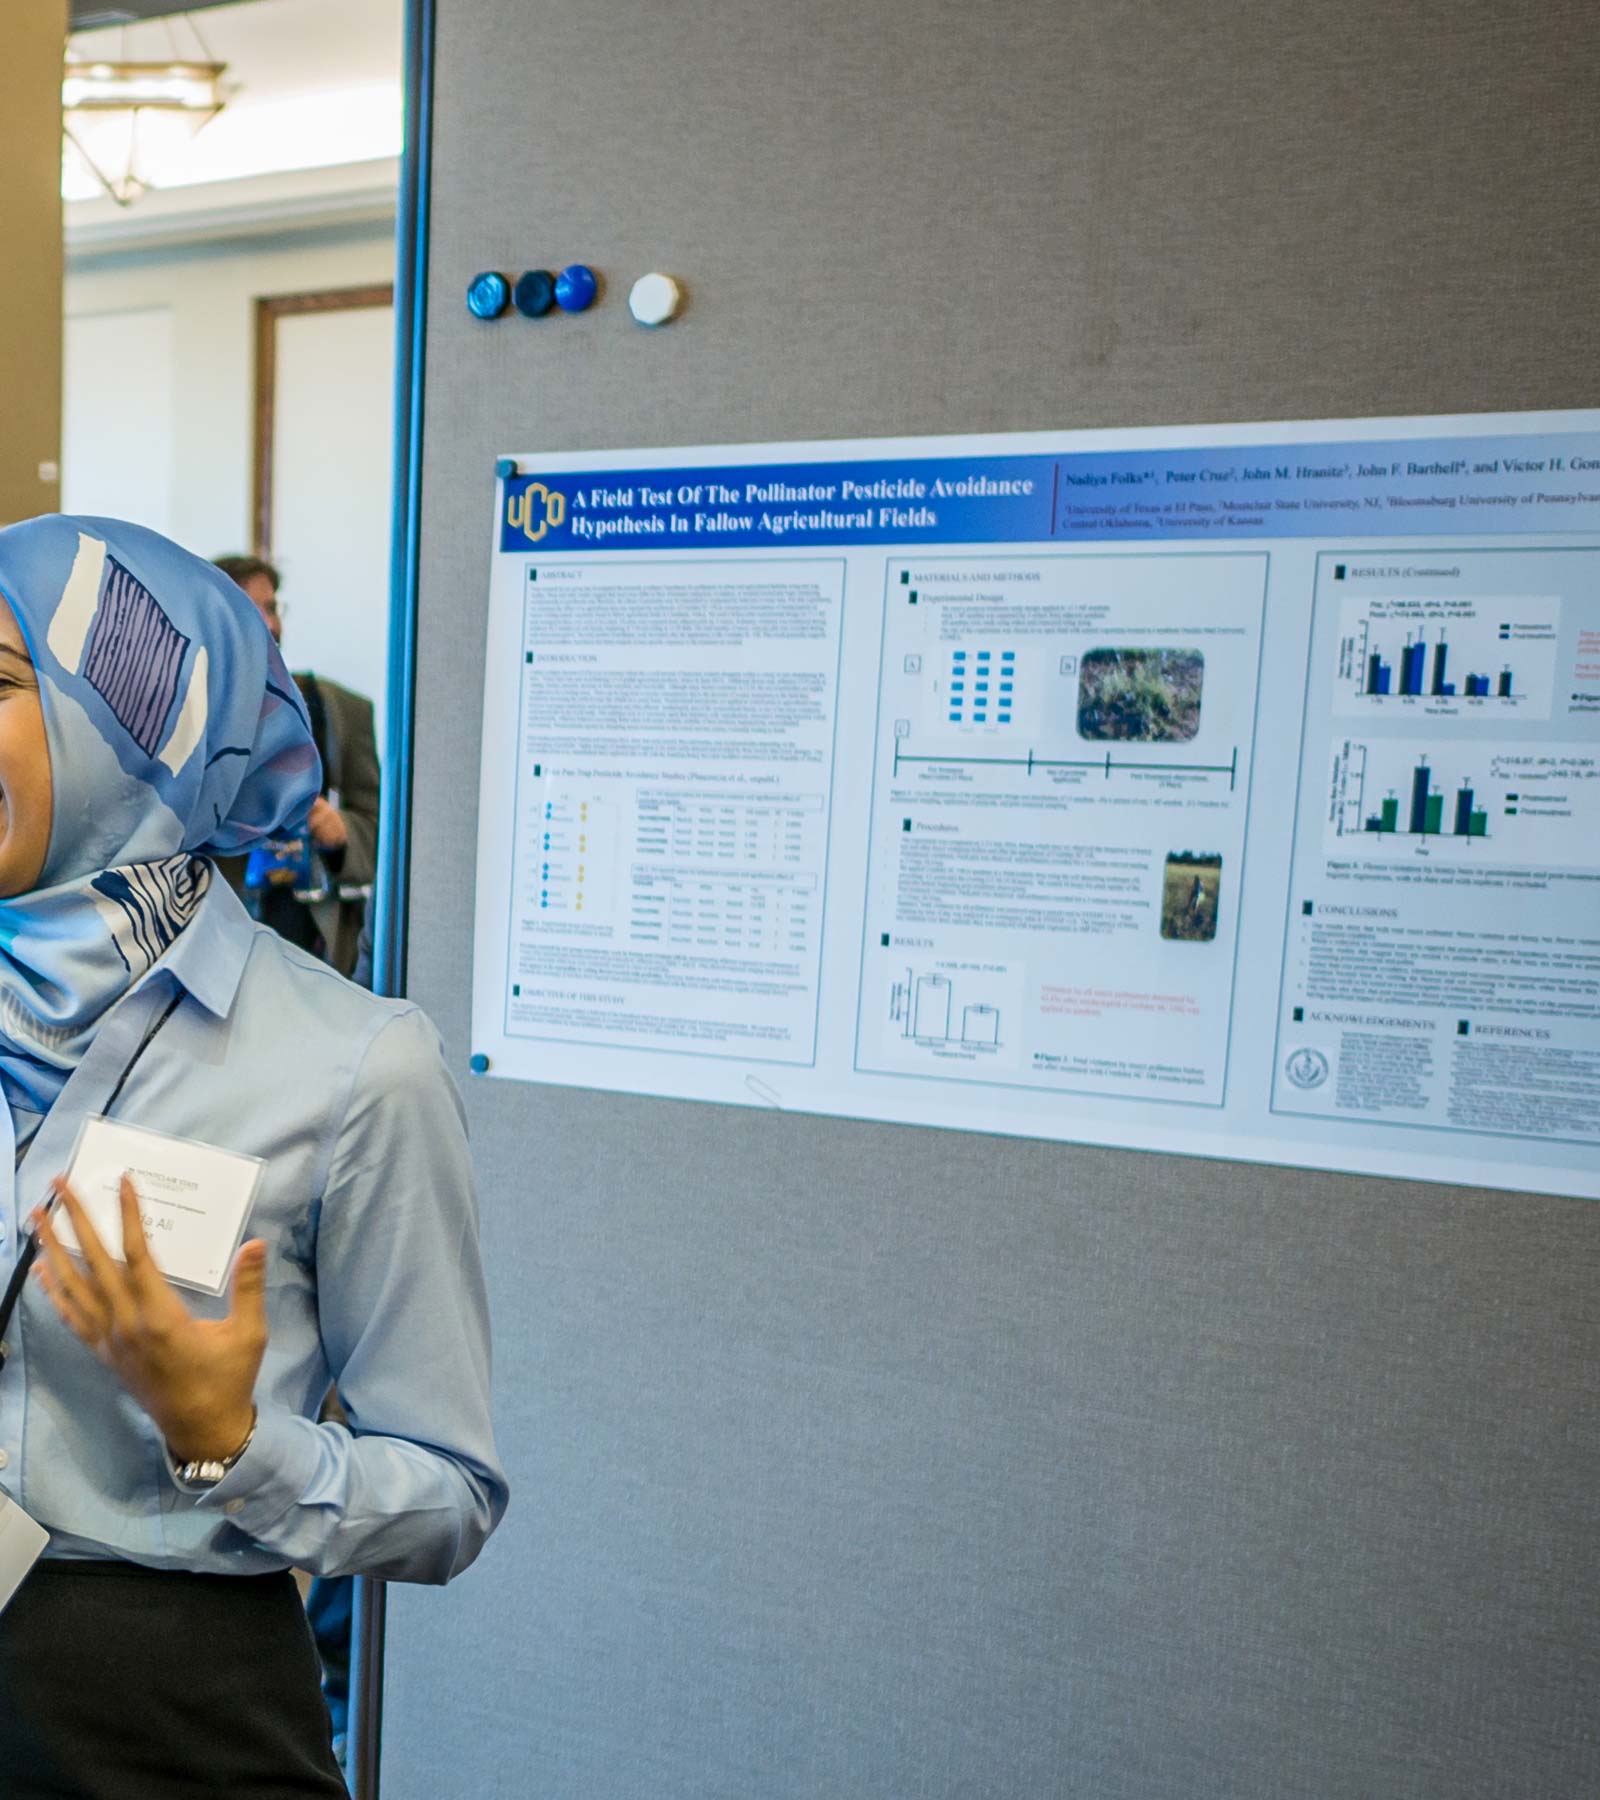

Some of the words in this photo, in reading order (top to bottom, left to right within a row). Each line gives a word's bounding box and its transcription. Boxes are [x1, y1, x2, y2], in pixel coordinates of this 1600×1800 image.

[1165, 469, 1197, 484] Peter
[1242, 467, 1271, 481] John
[1274, 466, 1292, 480] M.
[1356, 463, 1387, 478] John
[1472, 460, 1499, 474] and
[1502, 458, 1545, 473] Victor
[1549, 457, 1565, 471] H.
[571, 490, 587, 509] A
[590, 486, 634, 508] Field
[638, 486, 673, 507] Test
[677, 485, 703, 505] Of
[704, 484, 740, 504] The
[745, 482, 837, 504] Pollinator
[842, 478, 926, 500] Pesticide
[930, 475, 1034, 498] Avoidance
[1520, 493, 1534, 504] of
[571, 514, 665, 540] Hypothesis
[669, 513, 689, 533] In
[694, 511, 753, 533] Fallow
[757, 508, 873, 535] Agricultural
[879, 506, 937, 528] Fields
[1317, 903, 1398, 919] CONCLUSIONS
[1309, 1010, 1436, 1030] ACKNOWLEDGEMENTS
[1474, 1024, 1551, 1040] REFERENCES
